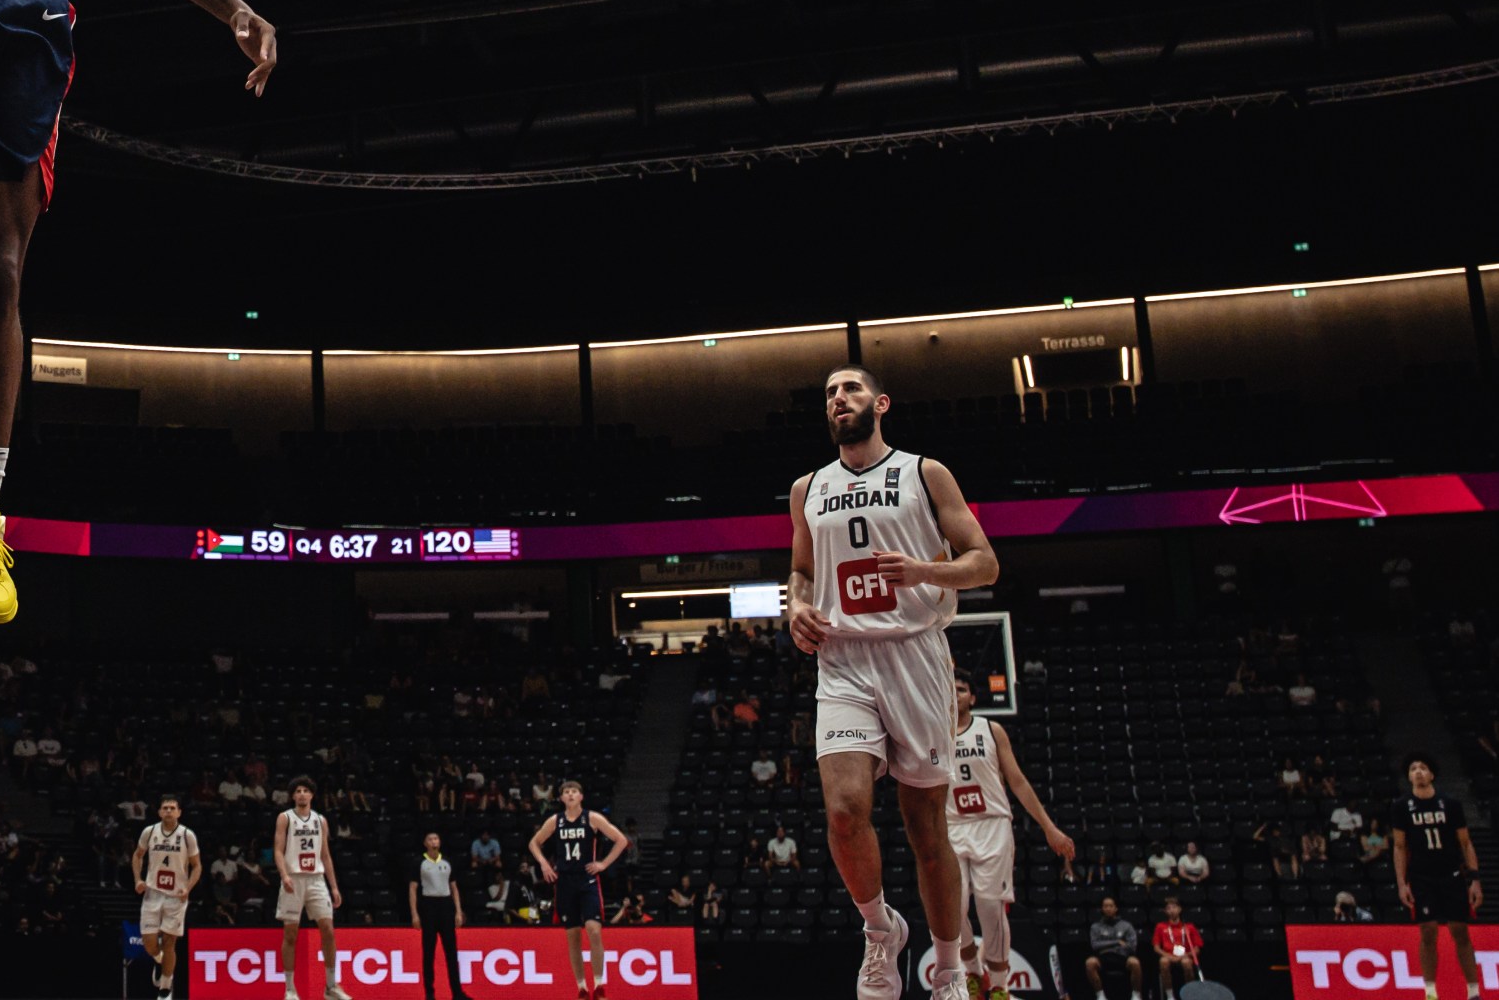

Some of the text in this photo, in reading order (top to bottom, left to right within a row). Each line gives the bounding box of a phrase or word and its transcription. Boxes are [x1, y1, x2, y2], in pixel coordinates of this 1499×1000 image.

[1041, 334, 1106, 351] Terrasse
[39, 363, 82, 377] Nuggets
[817, 490, 899, 516] JORDAN
[251, 530, 286, 552] 59
[423, 531, 471, 553] 120
[848, 516, 869, 549] 0
[296, 534, 413, 558] Q4 6:37 21
[846, 572, 888, 601] CFI
[956, 748, 985, 758] RDAN
[960, 764, 971, 780] 9
[958, 792, 982, 808] CFI
[1412, 811, 1446, 825] USA
[560, 827, 585, 840] USA
[1424, 827, 1442, 850] 11
[152, 844, 180, 852] JORDAN
[300, 838, 314, 850] 24
[564, 842, 581, 861] 14
[162, 855, 169, 867] 4
[301, 857, 315, 868] CFI
[159, 874, 173, 886] CFI
[194, 948, 286, 984] TCL
[318, 948, 419, 985] TCL
[457, 948, 553, 986] TCL
[581, 948, 692, 986] TCL
[1296, 948, 1426, 990] TCL
